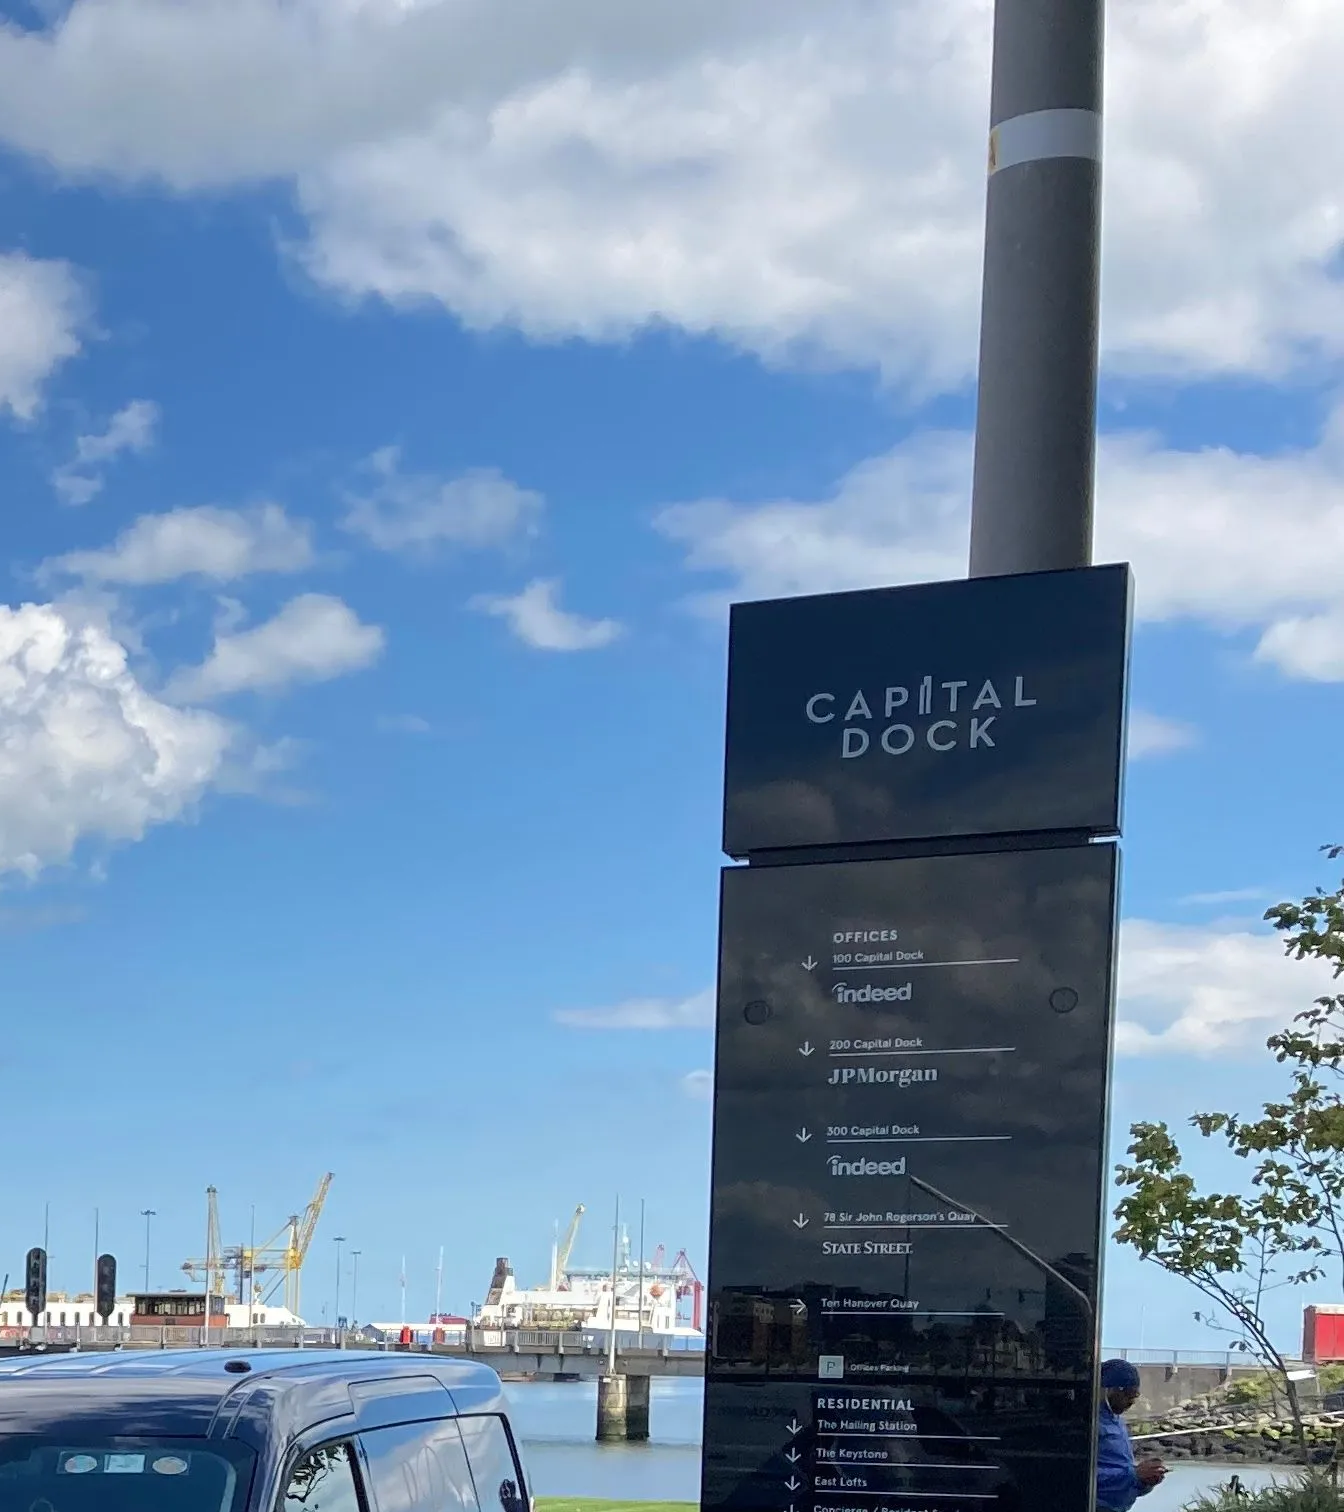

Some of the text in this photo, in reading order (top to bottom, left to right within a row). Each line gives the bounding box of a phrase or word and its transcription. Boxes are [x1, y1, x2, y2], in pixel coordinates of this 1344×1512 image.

[805, 675, 1037, 724] CAPITAL
[841, 716, 998, 759] DOCK
[832, 929, 898, 944] OFFICES
[832, 950, 925, 965] 100 Capital Dock
[832, 981, 912, 1004] indeed
[829, 1037, 923, 1051] 200 Capital Dock
[827, 1066, 938, 1088] JPMorgan
[826, 1124, 920, 1138] 300 Capital Dock
[826, 1155, 906, 1176] indeed
[824, 1212, 836, 1222] 78
[839, 1212, 852, 1222] Sir
[855, 1212, 883, 1222] John
[947, 1211, 977, 1223] Quay
[822, 1241, 861, 1255] STATE
[821, 1298, 920, 1310] Ten Hanover Quay
[816, 1398, 916, 1411] RESIDENTIAL
[817, 1419, 837, 1430] The
[878, 1420, 918, 1431] Station
[815, 1447, 889, 1460] The Keystone
[814, 1476, 868, 1487] East Lofts
